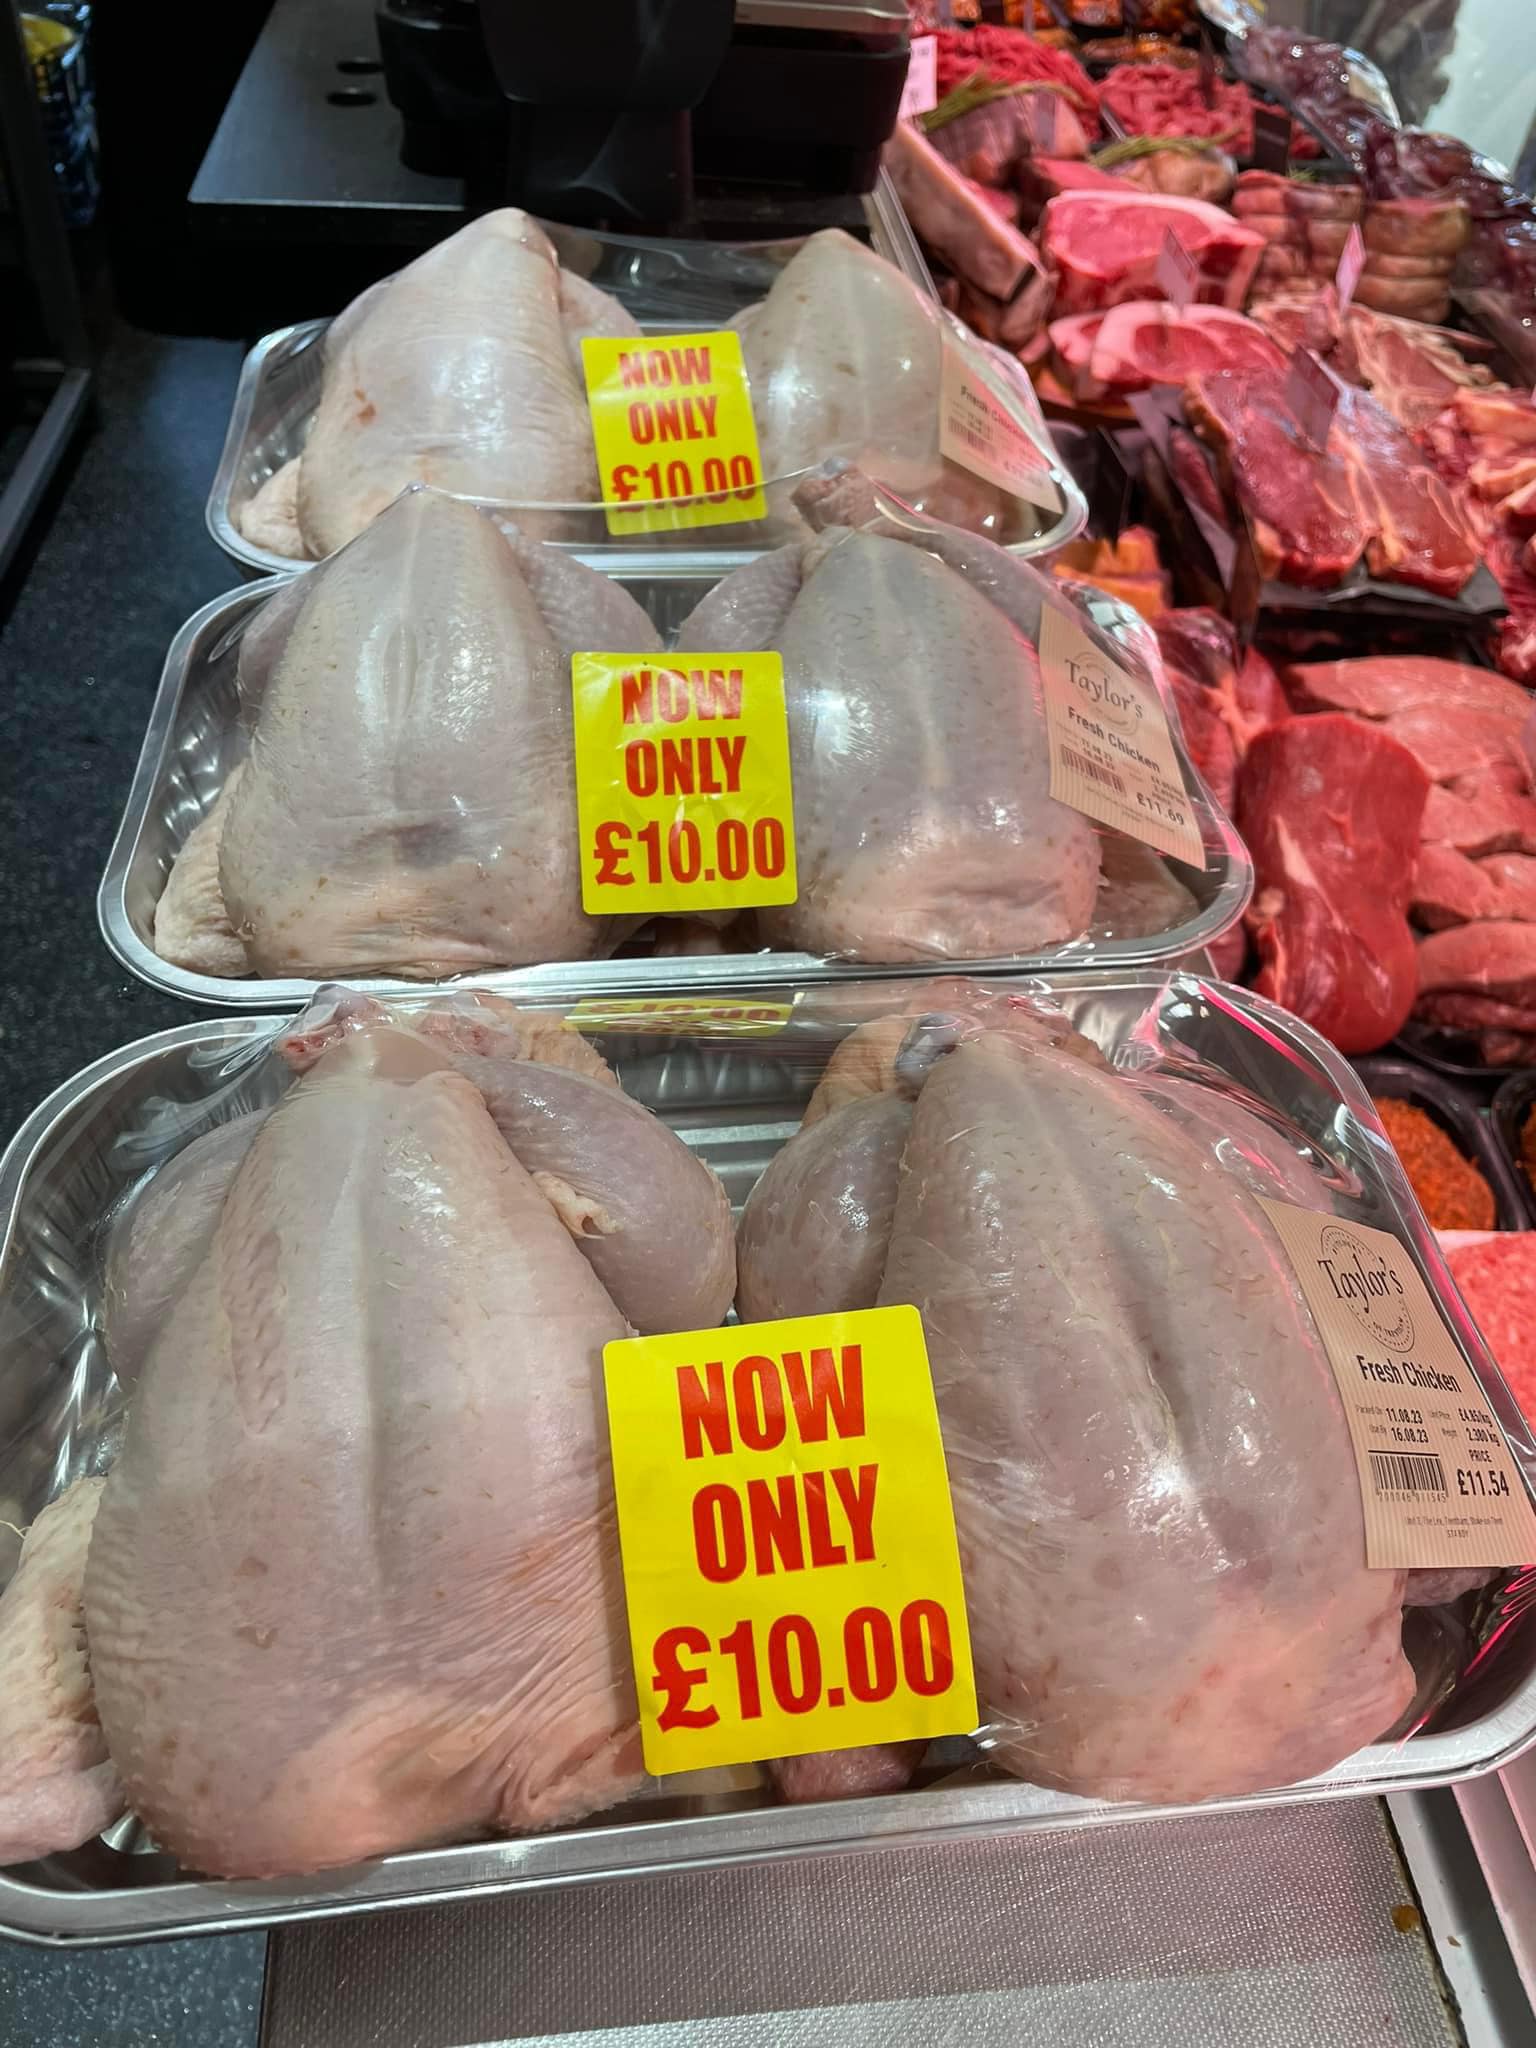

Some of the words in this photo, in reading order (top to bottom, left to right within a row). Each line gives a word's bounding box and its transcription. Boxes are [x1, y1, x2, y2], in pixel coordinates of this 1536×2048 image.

[619, 347, 712, 390] NOW
[629, 396, 718, 444] ONLY
[612, 455, 757, 513] £10.00
[621, 670, 743, 724] NOW
[1065, 659, 1144, 719] Taylor's
[625, 736, 746, 797] ONLY
[1068, 706, 1104, 740] Fresh
[1108, 733, 1160, 773] Chicken
[1136, 791, 1184, 825] £11.69
[594, 817, 785, 886] £10.00
[1317, 1253, 1403, 1313] Taylor's
[676, 1344, 866, 1459] NOW
[1356, 1355, 1403, 1384] Fresh
[1402, 1362, 1462, 1392] Chicken
[1386, 1408, 1423, 1424] 11.08.23
[1391, 1427, 1429, 1443] 16.08.23
[1457, 1468, 1509, 1496] £11.54
[1468, 1449, 1492, 1462] PRICE
[691, 1463, 879, 1584] ONLY
[652, 1599, 954, 1734] £10.00
